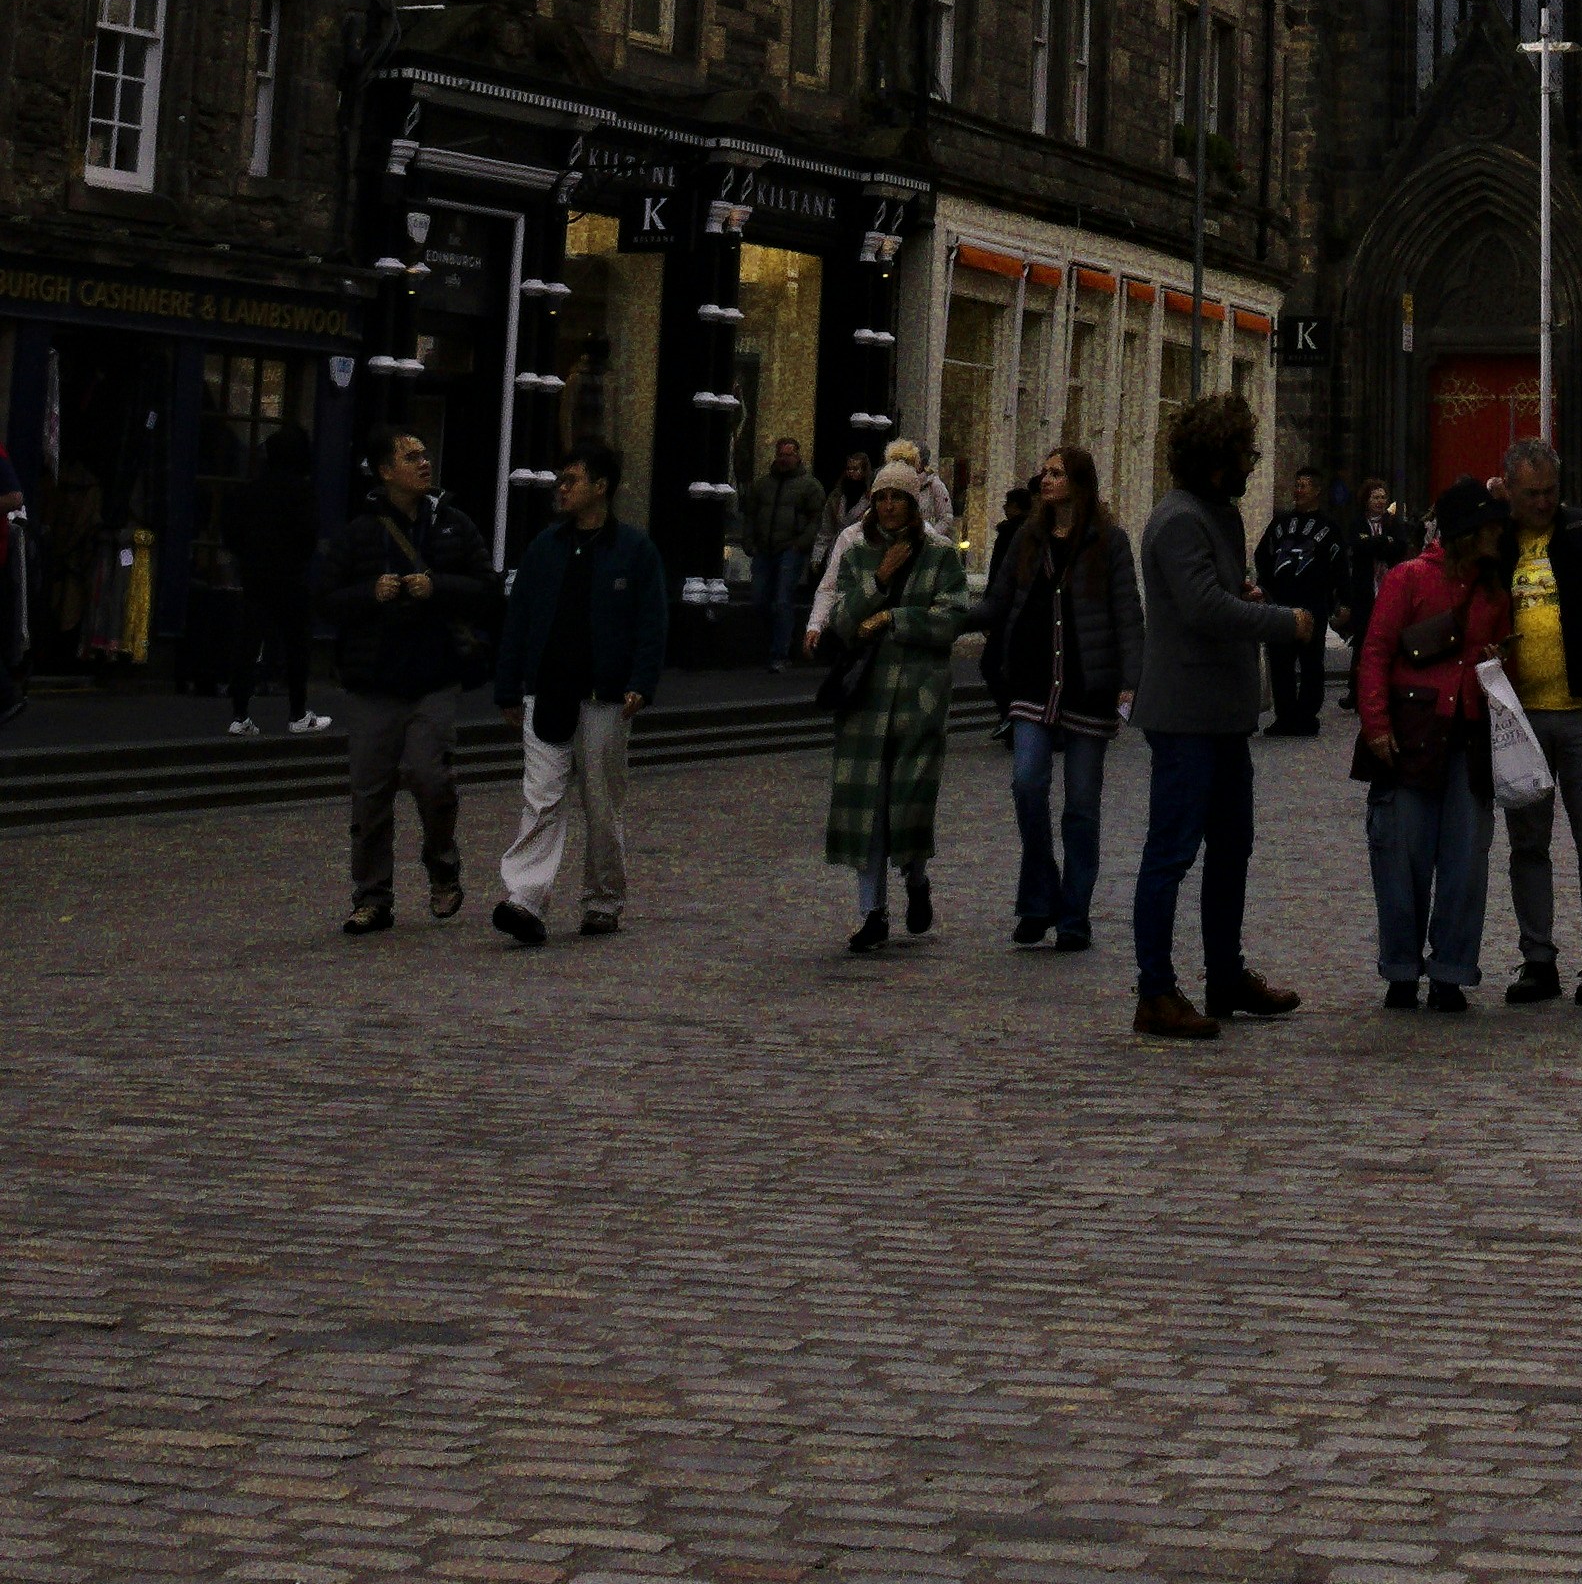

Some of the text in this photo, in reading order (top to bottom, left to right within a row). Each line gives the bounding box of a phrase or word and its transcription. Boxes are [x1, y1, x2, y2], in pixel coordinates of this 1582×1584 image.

[643, 197, 668, 231] K
[756, 183, 837, 219] KILTANE
[80, 280, 195, 319] CASHMERE
[201, 294, 216, 321] &
[222, 297, 352, 337] LAMBSWOOL
[1297, 322, 1319, 350] K
